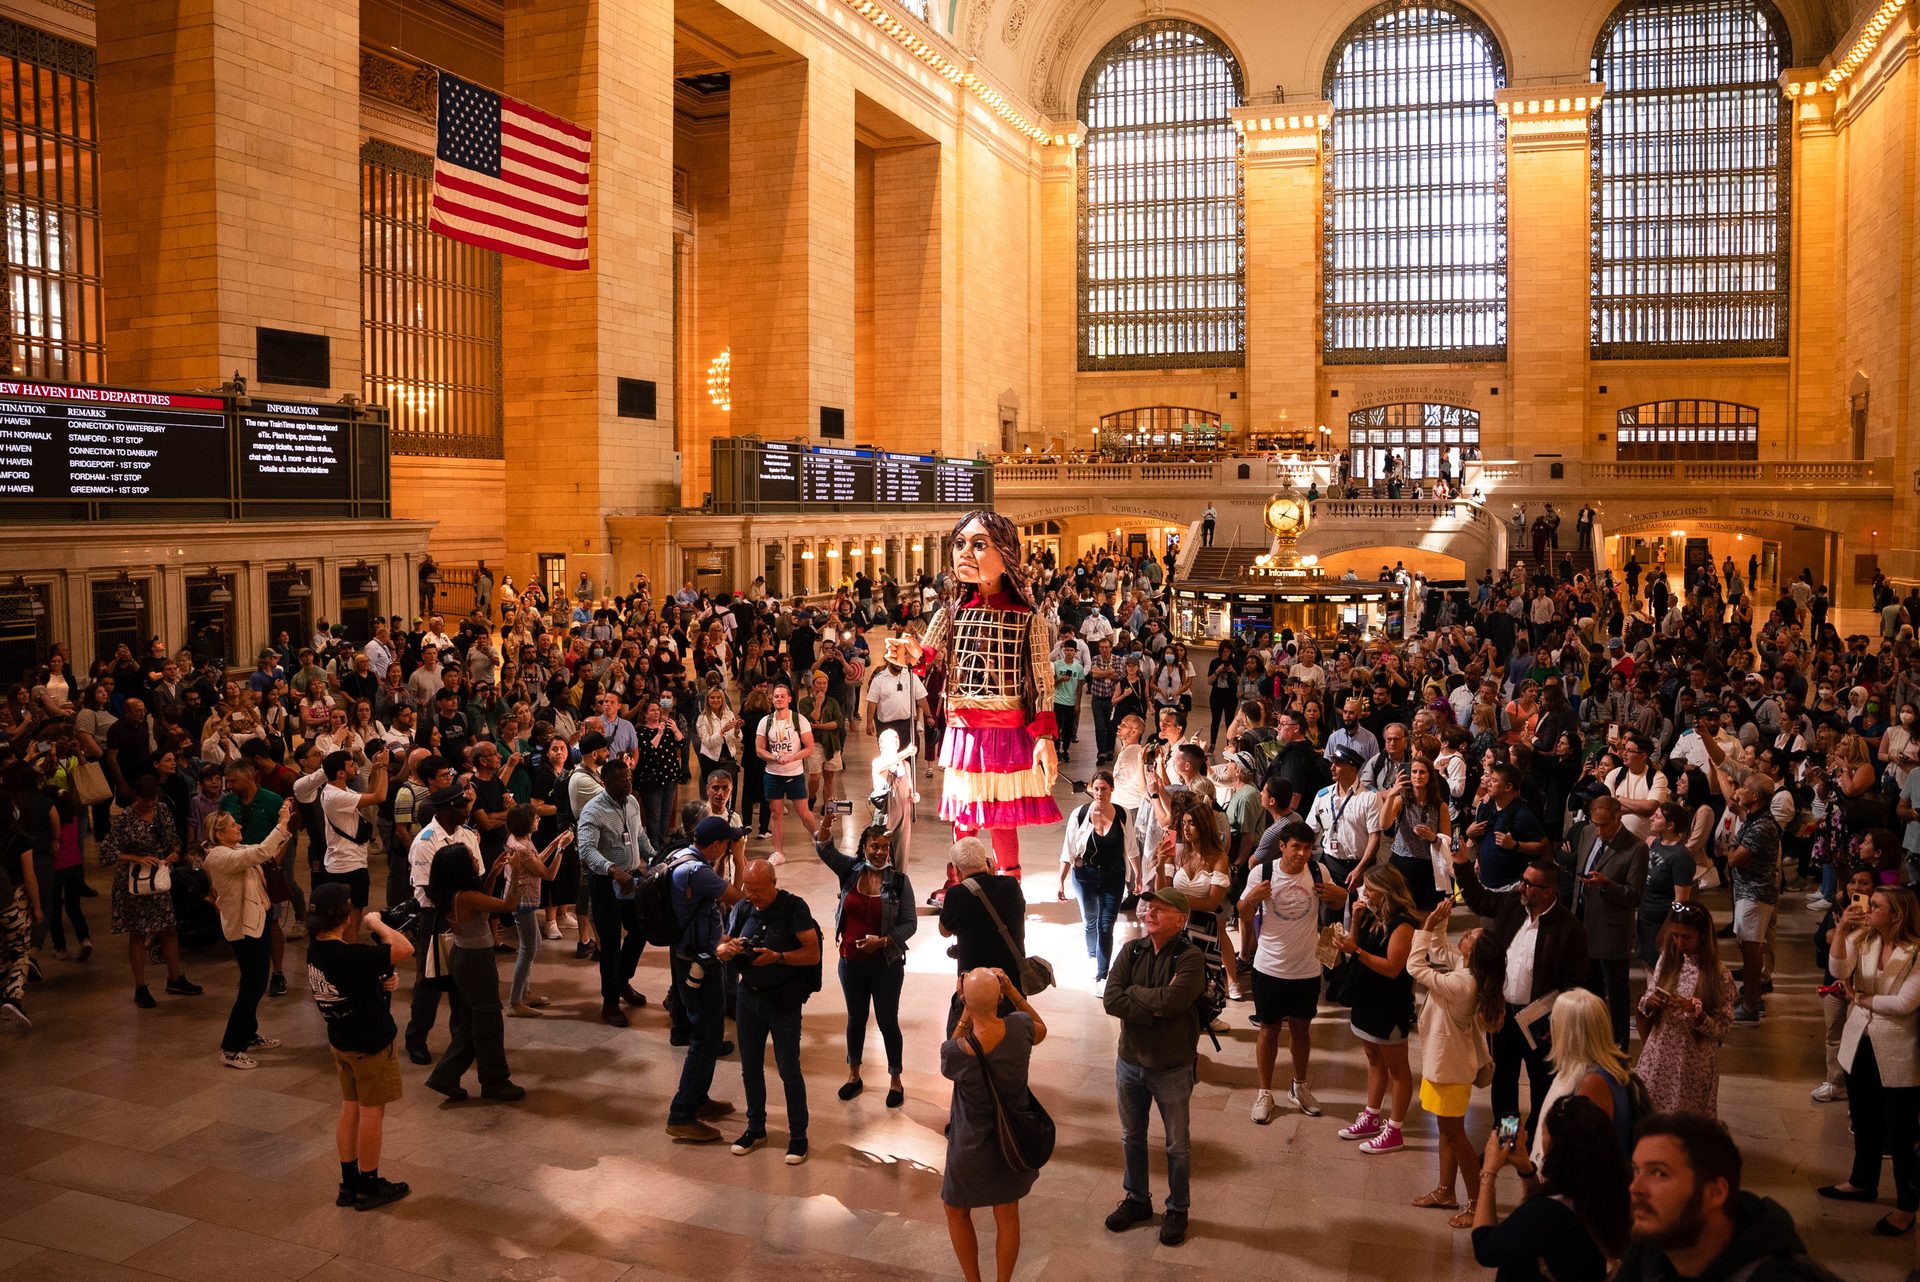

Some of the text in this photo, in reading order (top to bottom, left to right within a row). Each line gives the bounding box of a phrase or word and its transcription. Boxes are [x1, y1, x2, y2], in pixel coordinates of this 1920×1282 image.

[0, 382, 170, 406] EW HAVEN LINE DEPARTURES
[1424, 394, 1472, 406] APARTMENT
[0, 404, 46, 414] TINATION
[67, 408, 106, 418] REMARKS
[267, 404, 318, 415] INFORMATION
[4, 417, 30, 426] HAVEN
[68, 421, 114, 430] CONNECTION
[126, 424, 166, 432] WATERBURY
[14, 432, 52, 440] NORWALK
[68, 434, 107, 442] STAMFORD
[6, 444, 32, 452] HAVEN
[68, 447, 115, 456] CONNECTION
[70, 460, 115, 468] BRIDGEPORT
[1016, 505, 1086, 521] TICKET MACHINES
[1111, 505, 1141, 514] SUBWAY
[1149, 510, 1168, 518] 42ND
[1631, 507, 1709, 522] TICKET MACHINES
[1740, 508, 1774, 517] TRACKS
[1788, 512, 1800, 520] TO
[1698, 522, 1758, 533] WAITING ROOM
